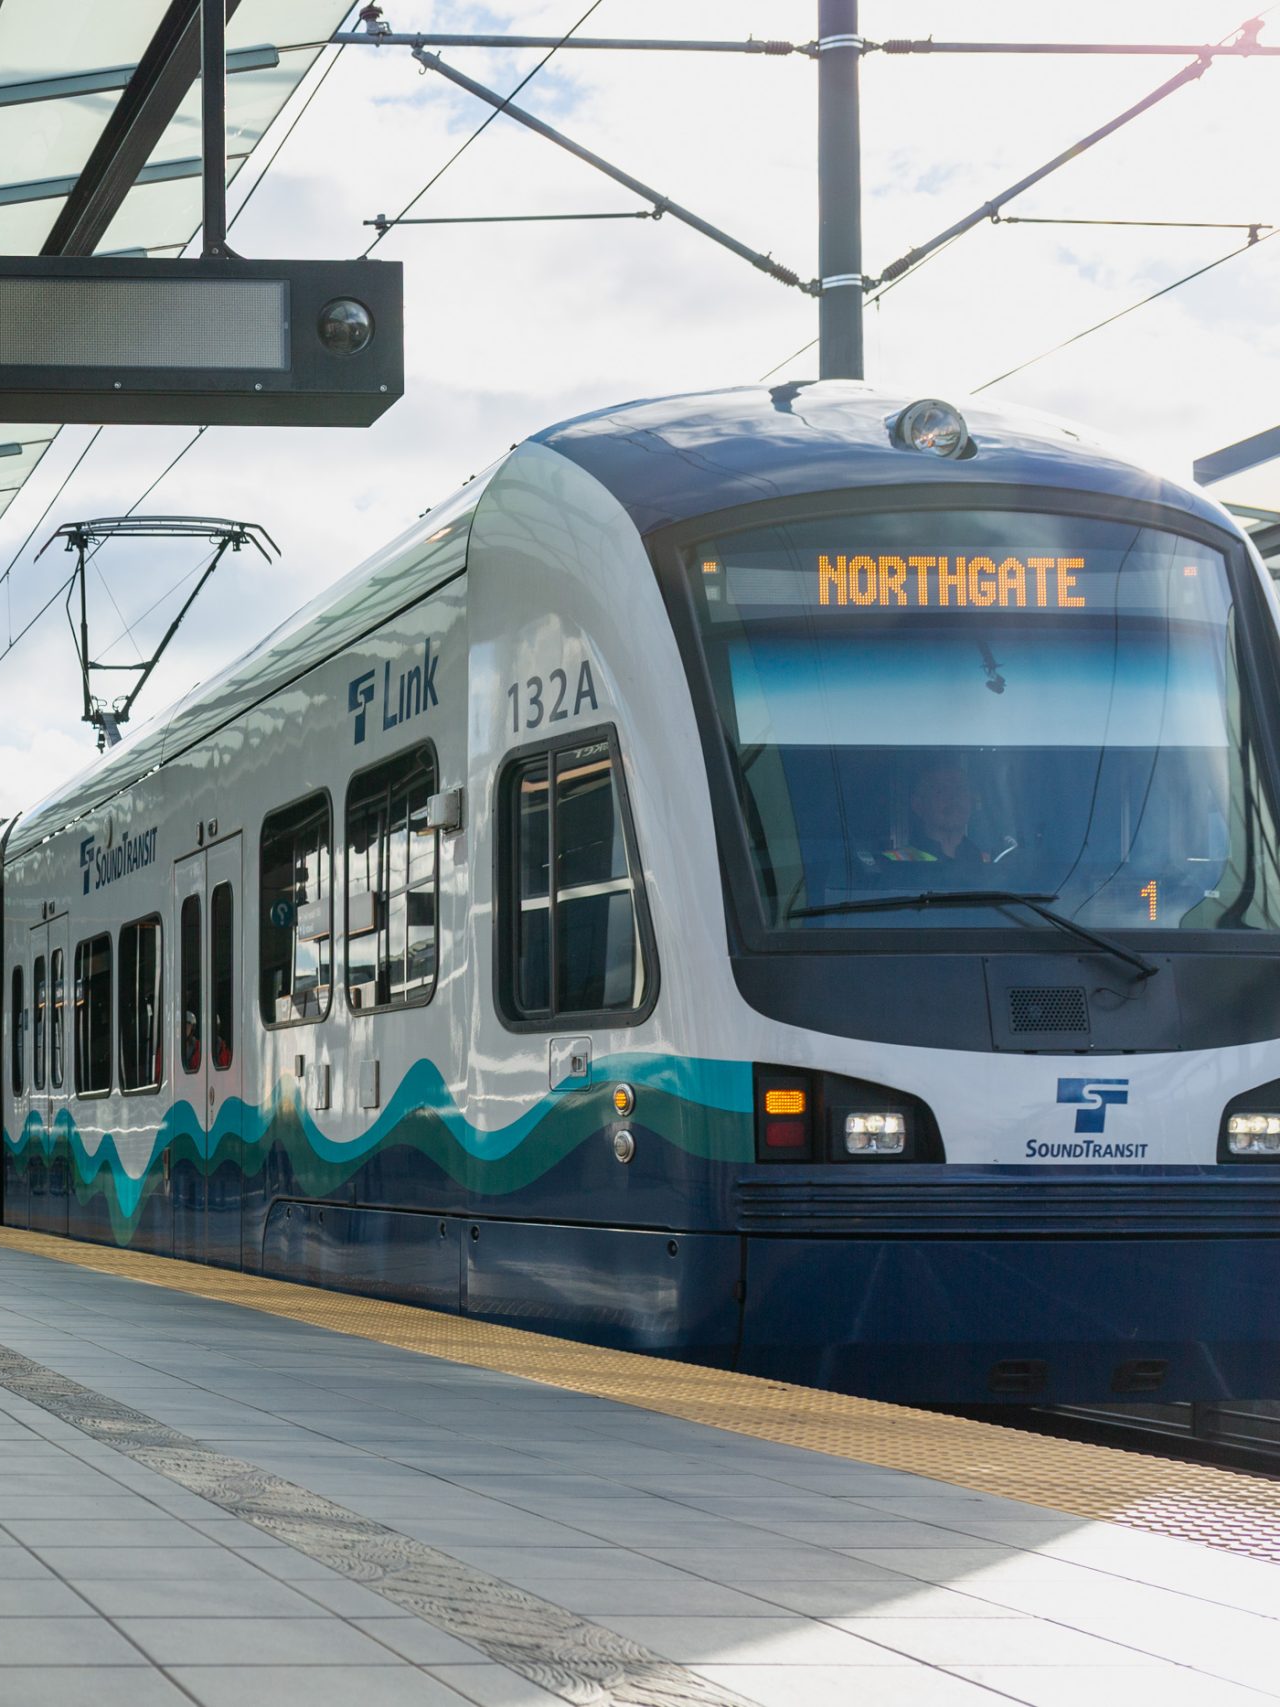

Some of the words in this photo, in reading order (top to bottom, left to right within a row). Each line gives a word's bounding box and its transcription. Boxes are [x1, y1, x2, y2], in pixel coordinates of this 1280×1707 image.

[818, 555, 1086, 608] NORTHGATE
[382, 636, 439, 732] Link
[507, 659, 599, 733] 132A
[1140, 880, 1157, 920] 1
